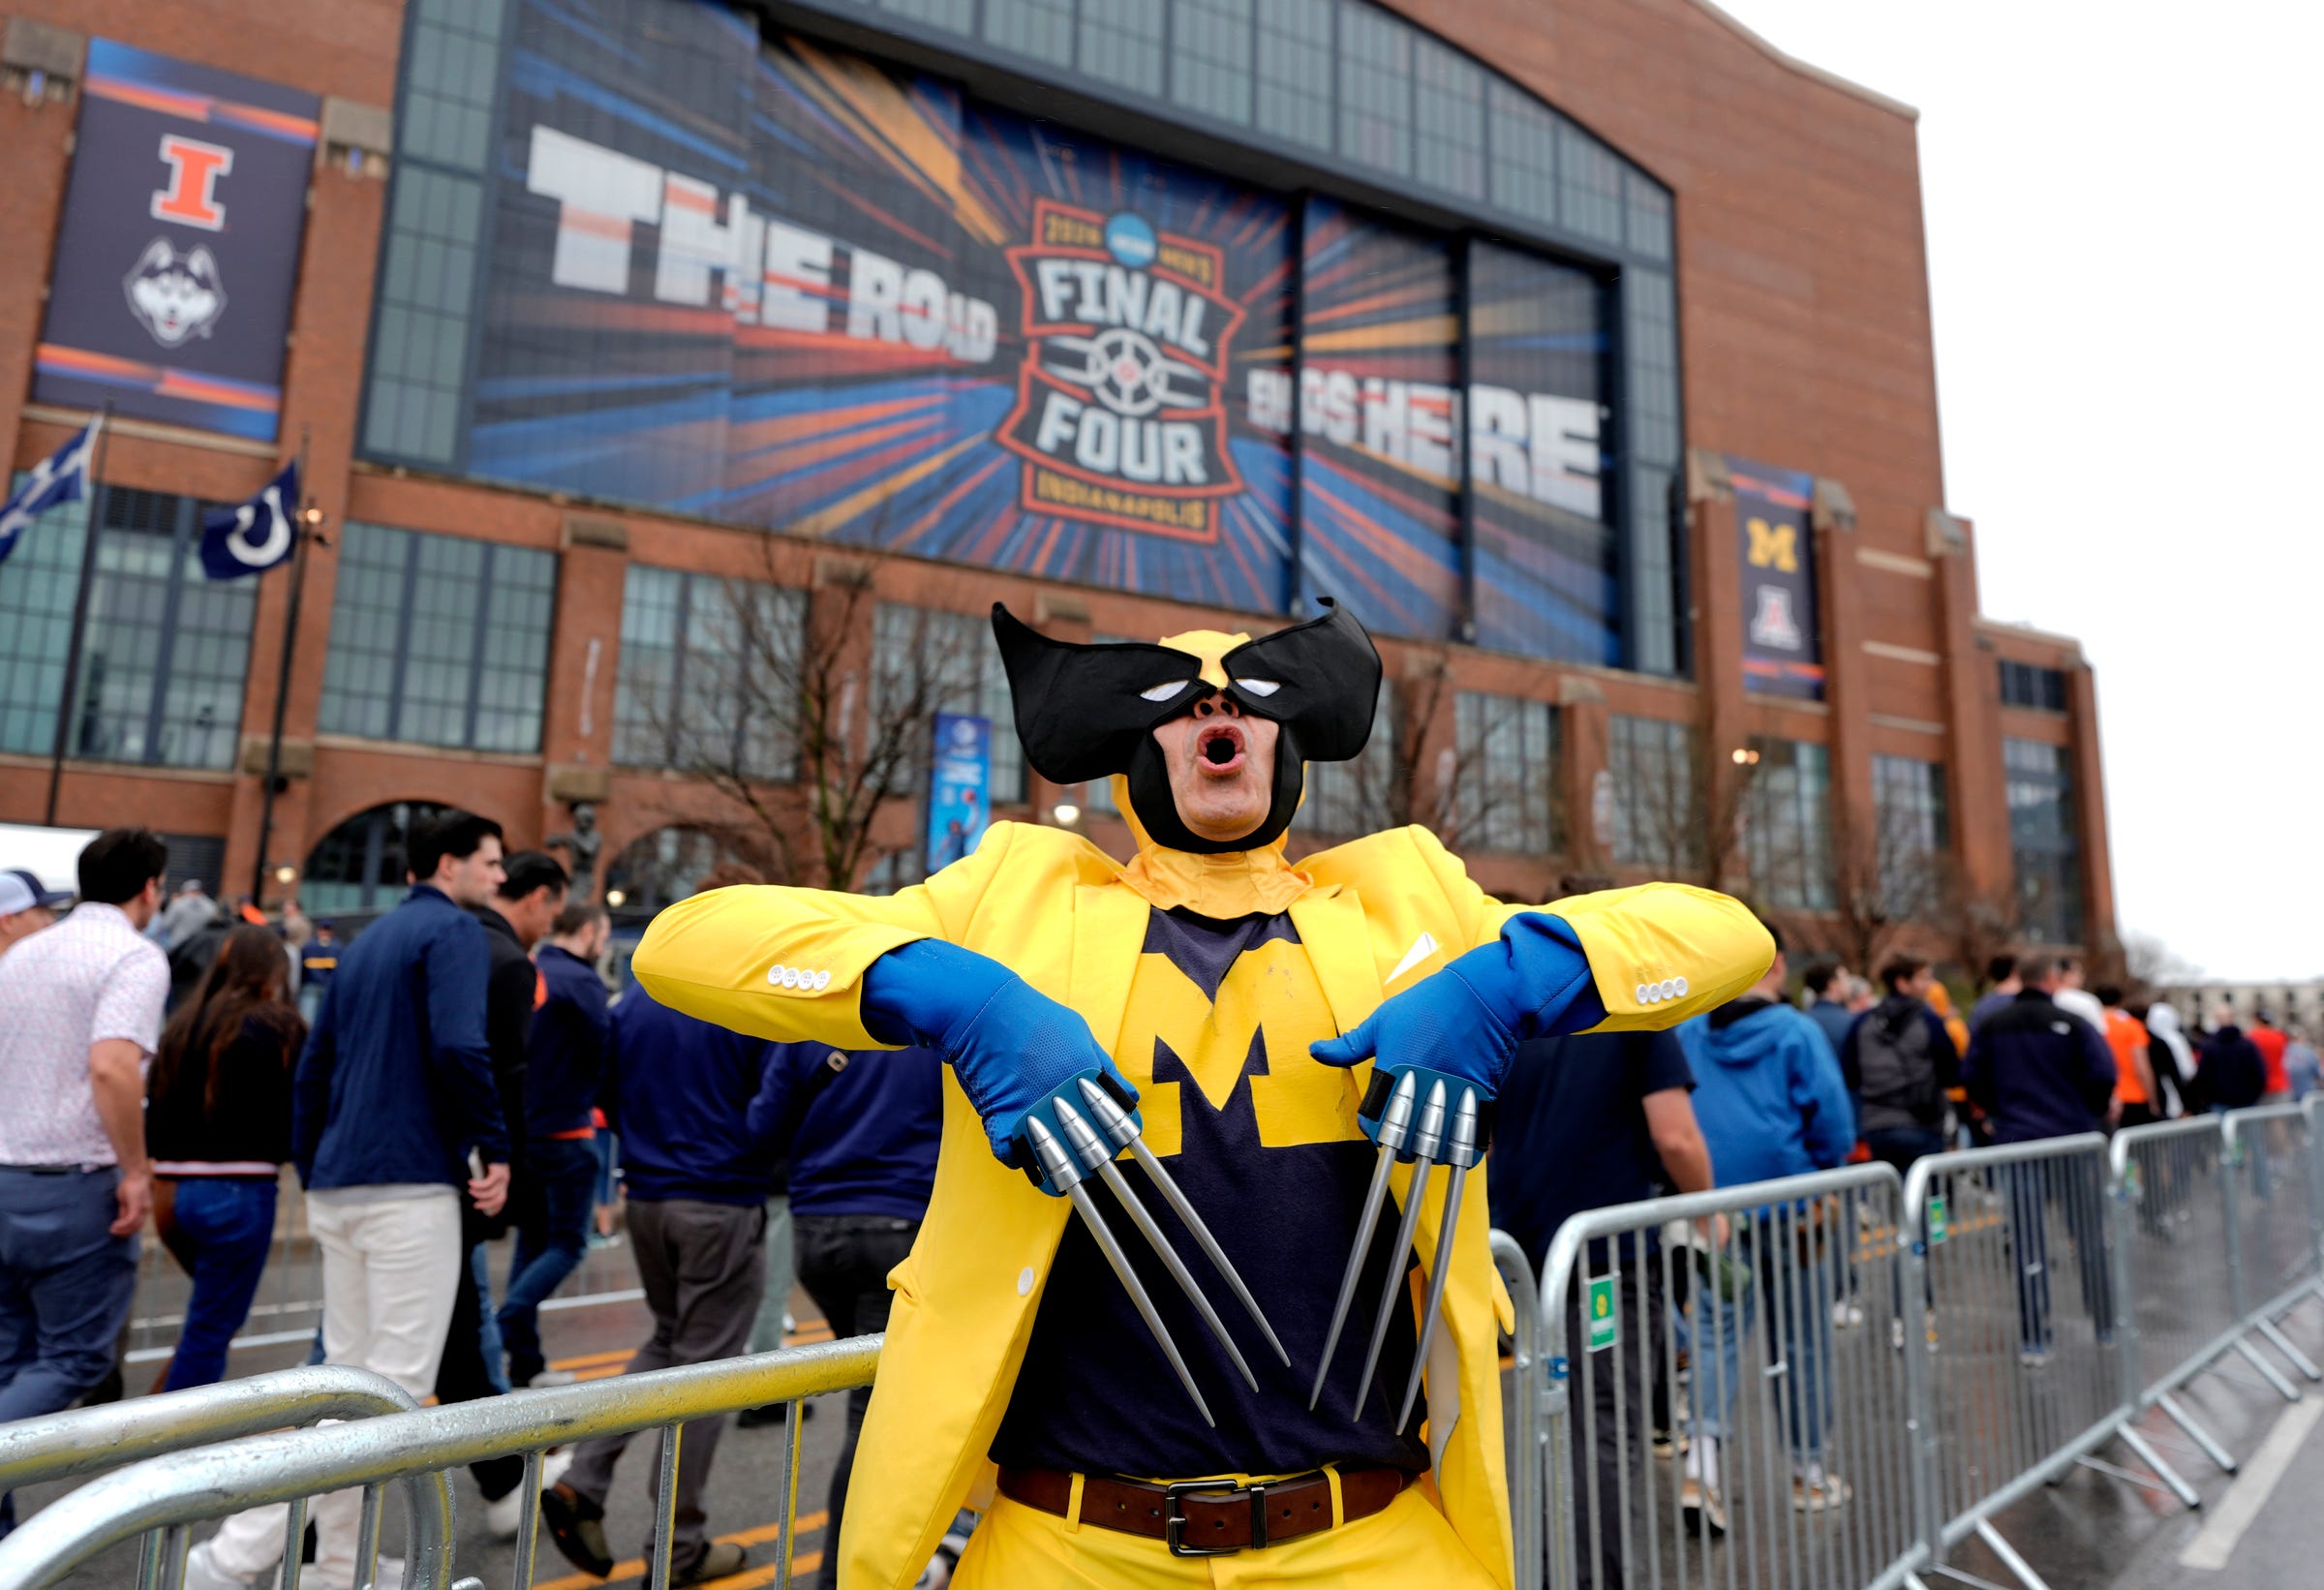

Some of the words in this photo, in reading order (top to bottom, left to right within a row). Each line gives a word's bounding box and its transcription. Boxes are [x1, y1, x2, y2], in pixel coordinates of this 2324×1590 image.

[150, 133, 233, 231] I
[527, 123, 835, 333] THE
[846, 246, 998, 363] ROAD
[1036, 258, 1209, 357] FINAL
[1035, 389, 1208, 483] FOUR
[1363, 378, 1602, 518] HERE
[1037, 469, 1206, 529] INDIANAPOLIS
[1746, 517, 1797, 573] M
[1750, 583, 1801, 651] A
[1115, 936, 1368, 1161] M
